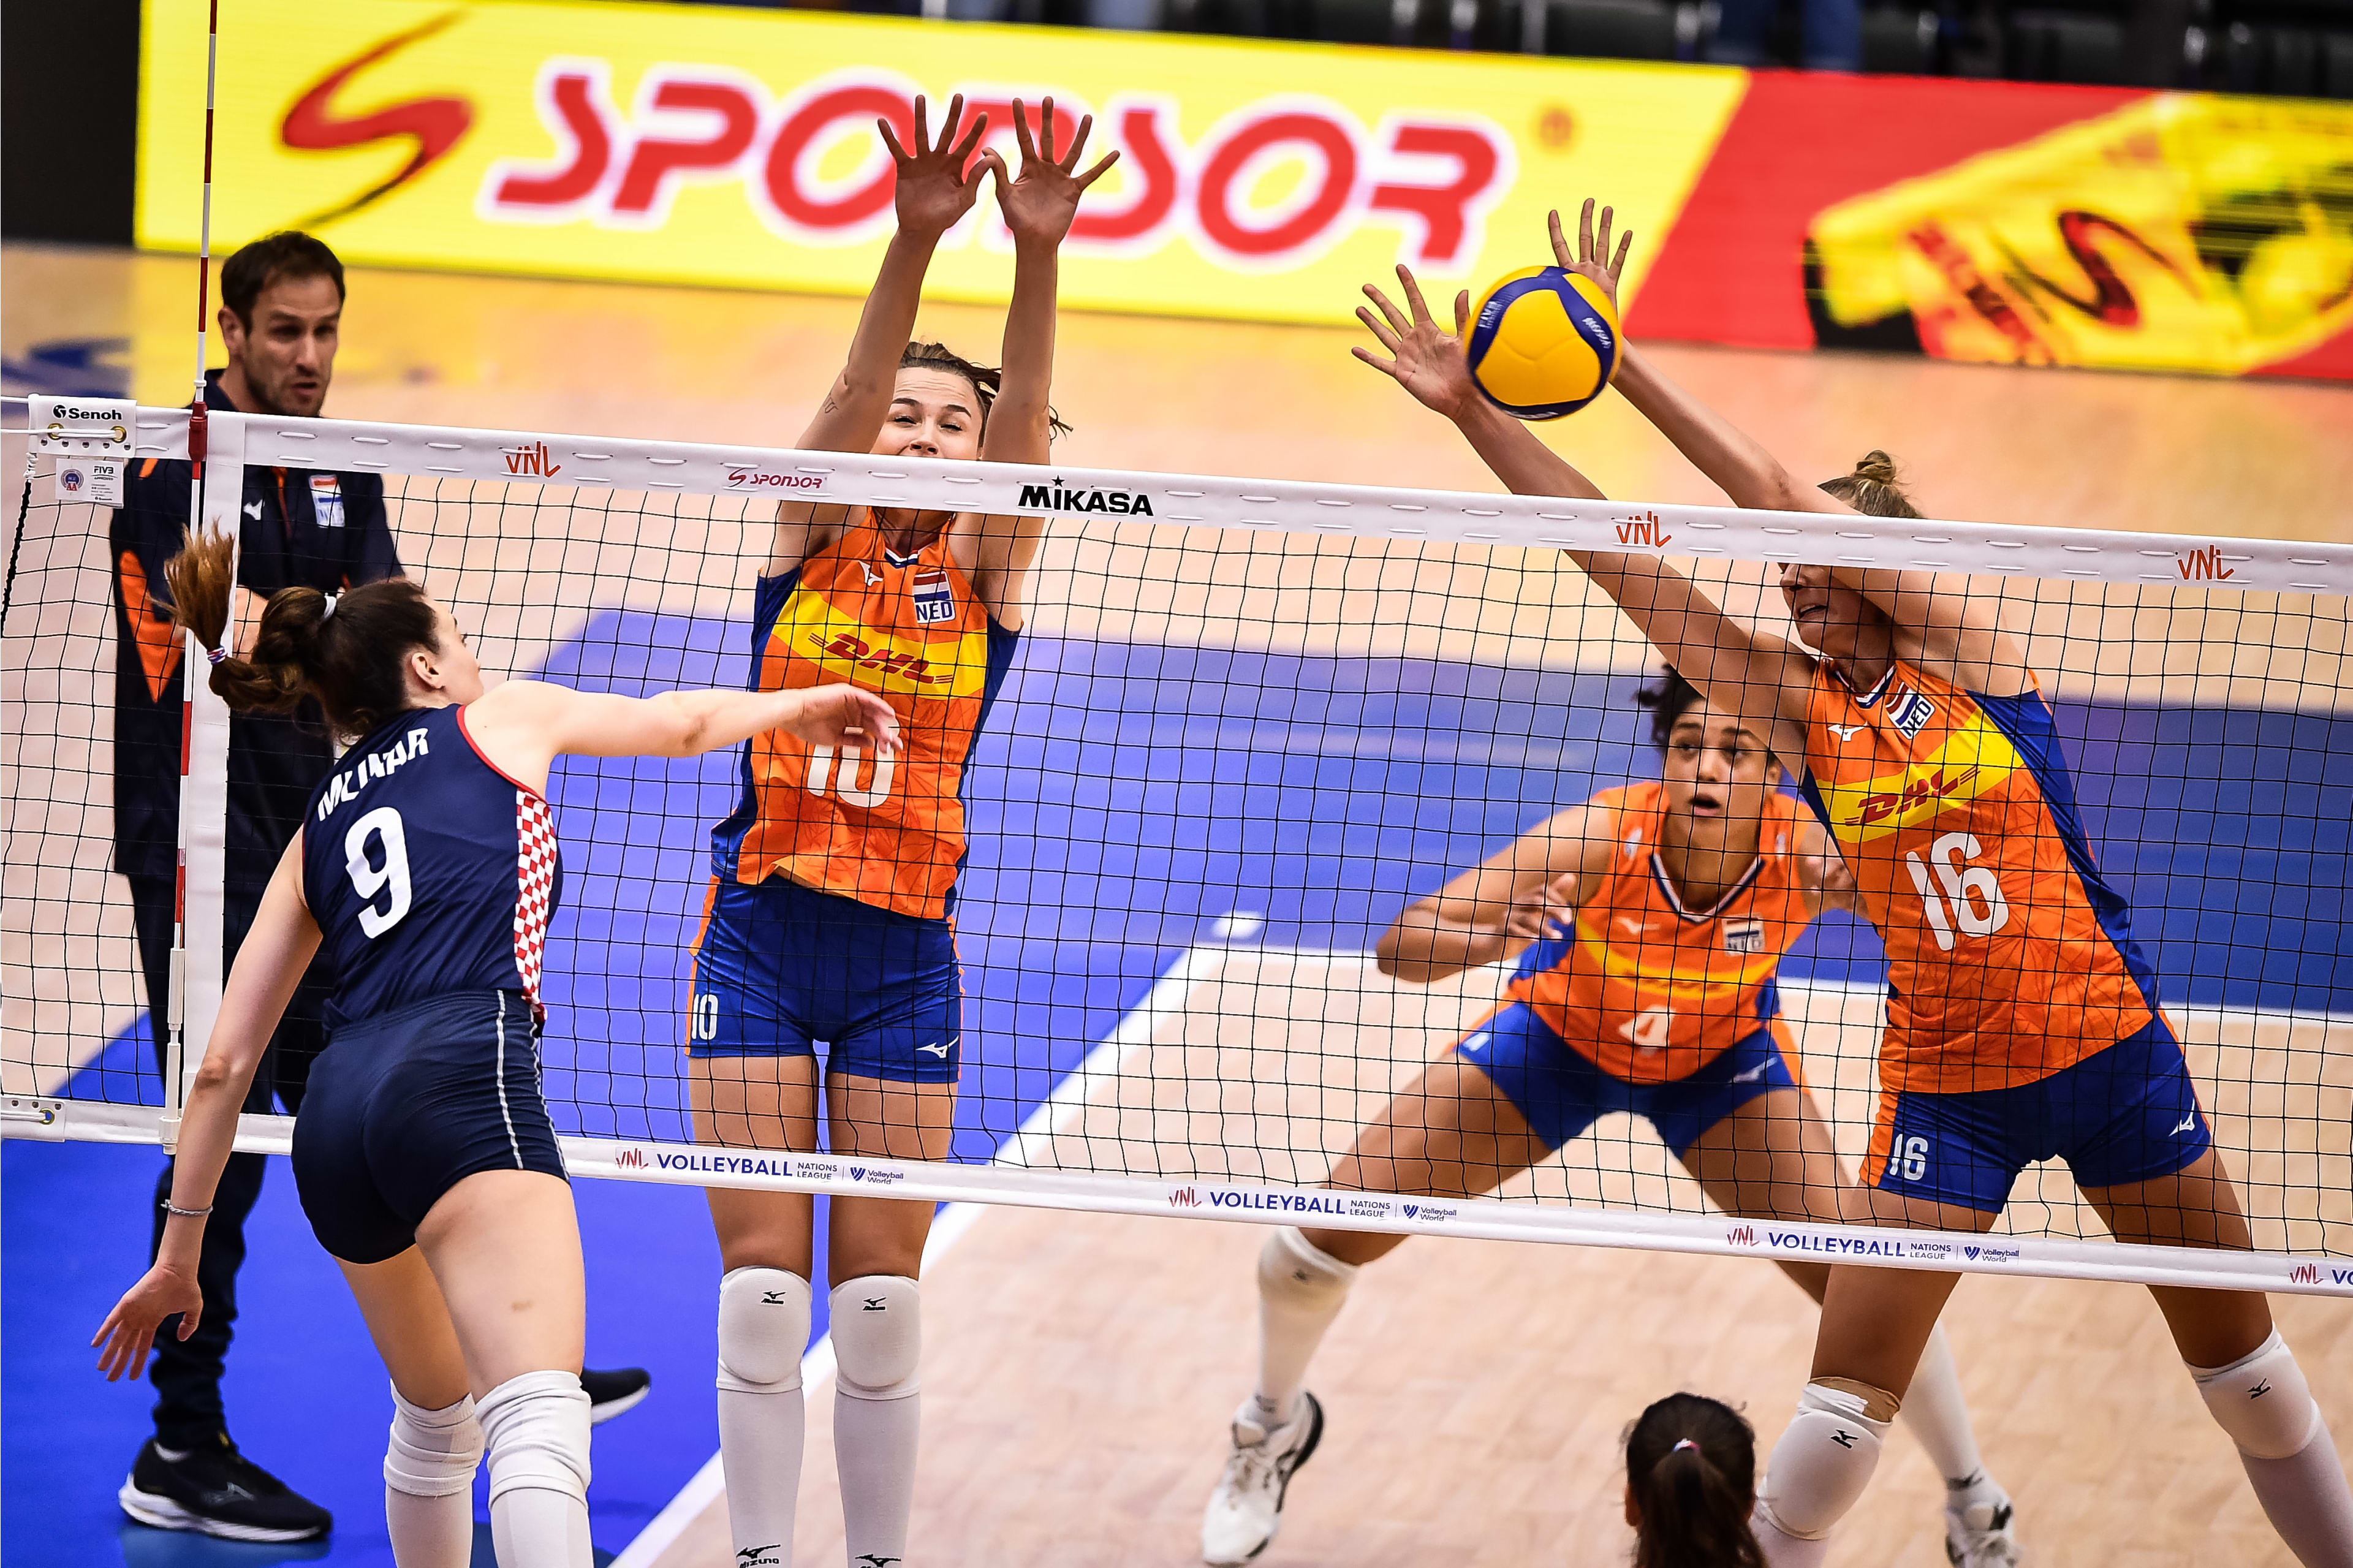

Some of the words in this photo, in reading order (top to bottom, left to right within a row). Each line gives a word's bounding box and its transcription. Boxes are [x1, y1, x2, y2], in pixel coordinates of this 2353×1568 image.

[68, 407, 122, 420] Senoh
[504, 441, 561, 478] VNL
[749, 473, 823, 489] SPONSOR
[1017, 475, 1154, 517] MIKASA
[1615, 510, 1672, 548] VNL
[2177, 544, 2235, 580] VNL
[915, 601, 953, 621] NED
[823, 632, 935, 684] DHL
[1901, 700, 1931, 737] NED
[806, 725, 896, 808] 10
[1857, 768, 1958, 825] DHL
[344, 806, 412, 939] 9
[1906, 831, 2009, 951] 16
[691, 993, 719, 1041] 10
[1618, 1003, 1677, 1056] 4
[616, 1148, 649, 1170] VNL
[656, 1153, 794, 1177] VOLLEYBALL
[797, 1162, 838, 1172] NATIONS
[1889, 1132, 1930, 1181] 16
[797, 1171, 832, 1180] LEAGUE
[867, 1176, 892, 1185] World
[868, 1170, 904, 1180] Volleyball
[1169, 1186, 1202, 1208] VNL
[1209, 1191, 1346, 1214] VOLLEYBALL
[1349, 1208, 1385, 1218] LEAGUE
[1350, 1200, 1390, 1210] NATIONS
[1420, 1206, 1457, 1217] Volleyball
[1727, 1225, 1760, 1247] VNL
[1768, 1232, 1906, 1257] VOLLEYBALL
[1910, 1243, 1952, 1252] NATIONS
[1982, 1248, 2020, 1257] Volleyball
[1909, 1251, 1946, 1260] LEAGUE
[2289, 1263, 2324, 1285] VNL
